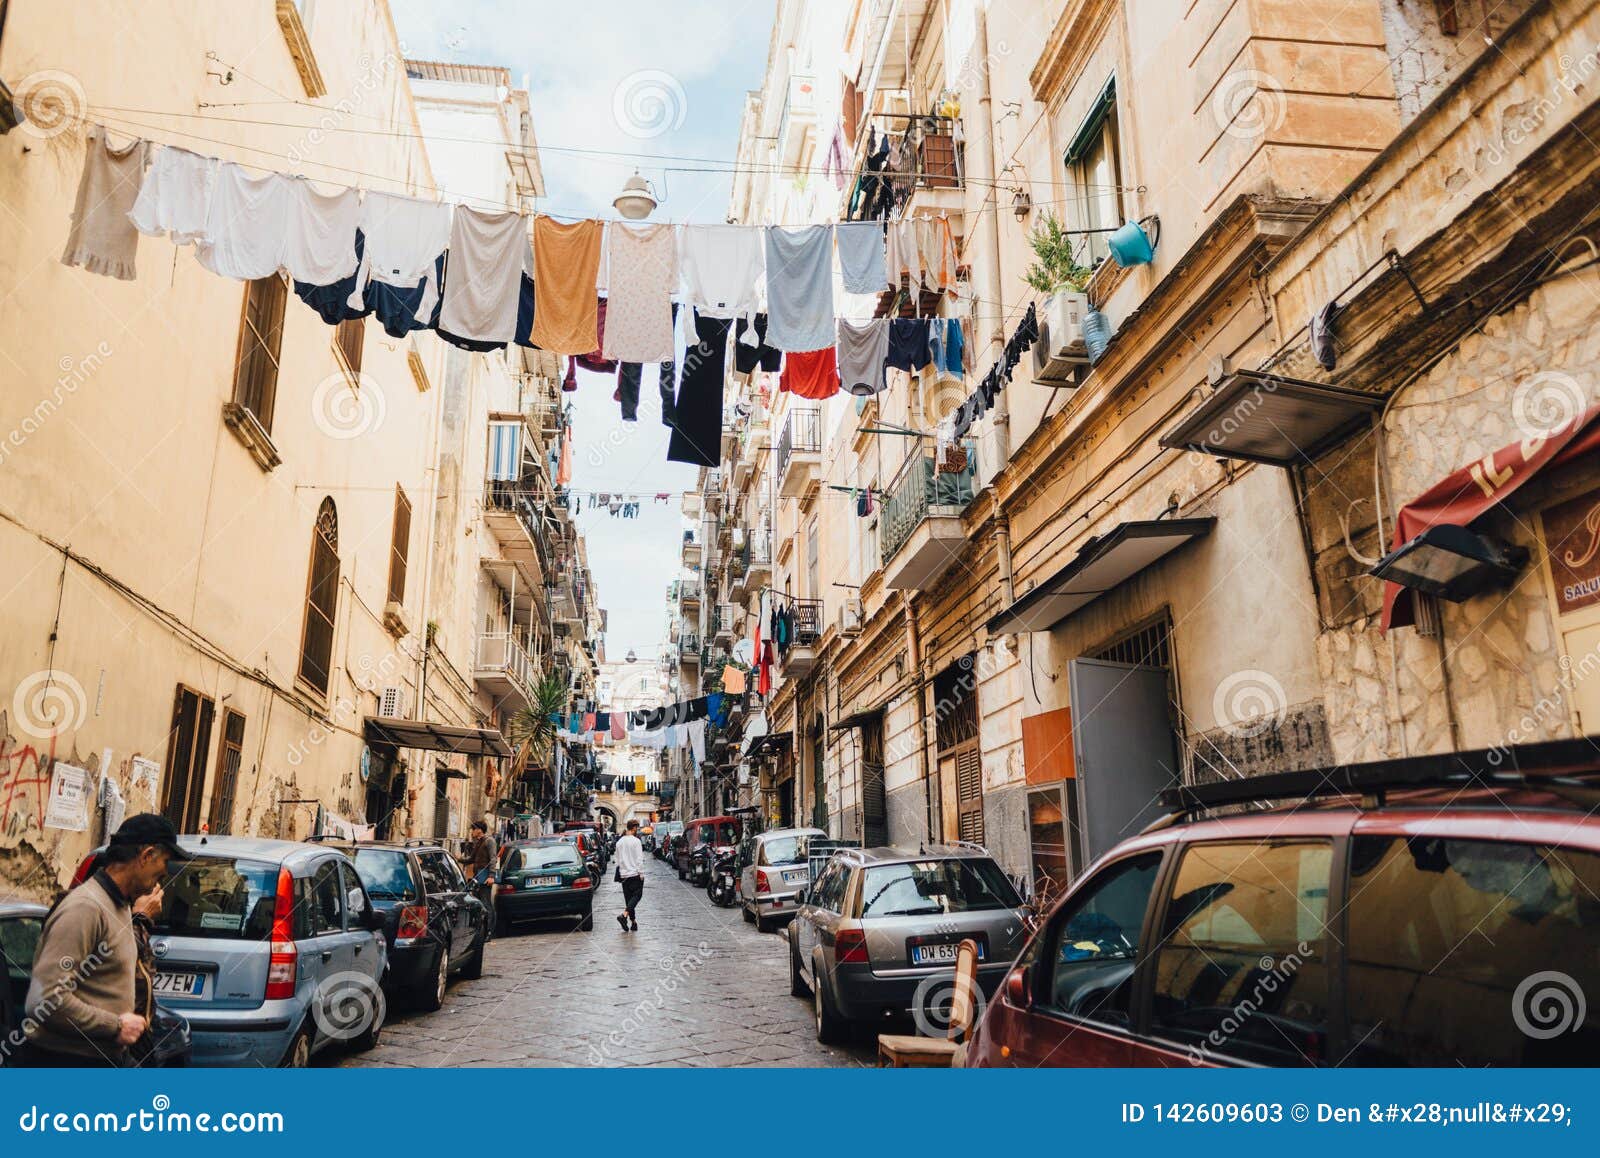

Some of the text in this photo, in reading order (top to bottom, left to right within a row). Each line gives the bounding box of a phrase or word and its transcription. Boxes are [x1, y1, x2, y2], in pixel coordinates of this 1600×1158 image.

[1470, 453, 1514, 498] IL
[1564, 576, 1600, 601] SALU
[921, 944, 959, 959] DW 630
[153, 973, 195, 992] 27EW
